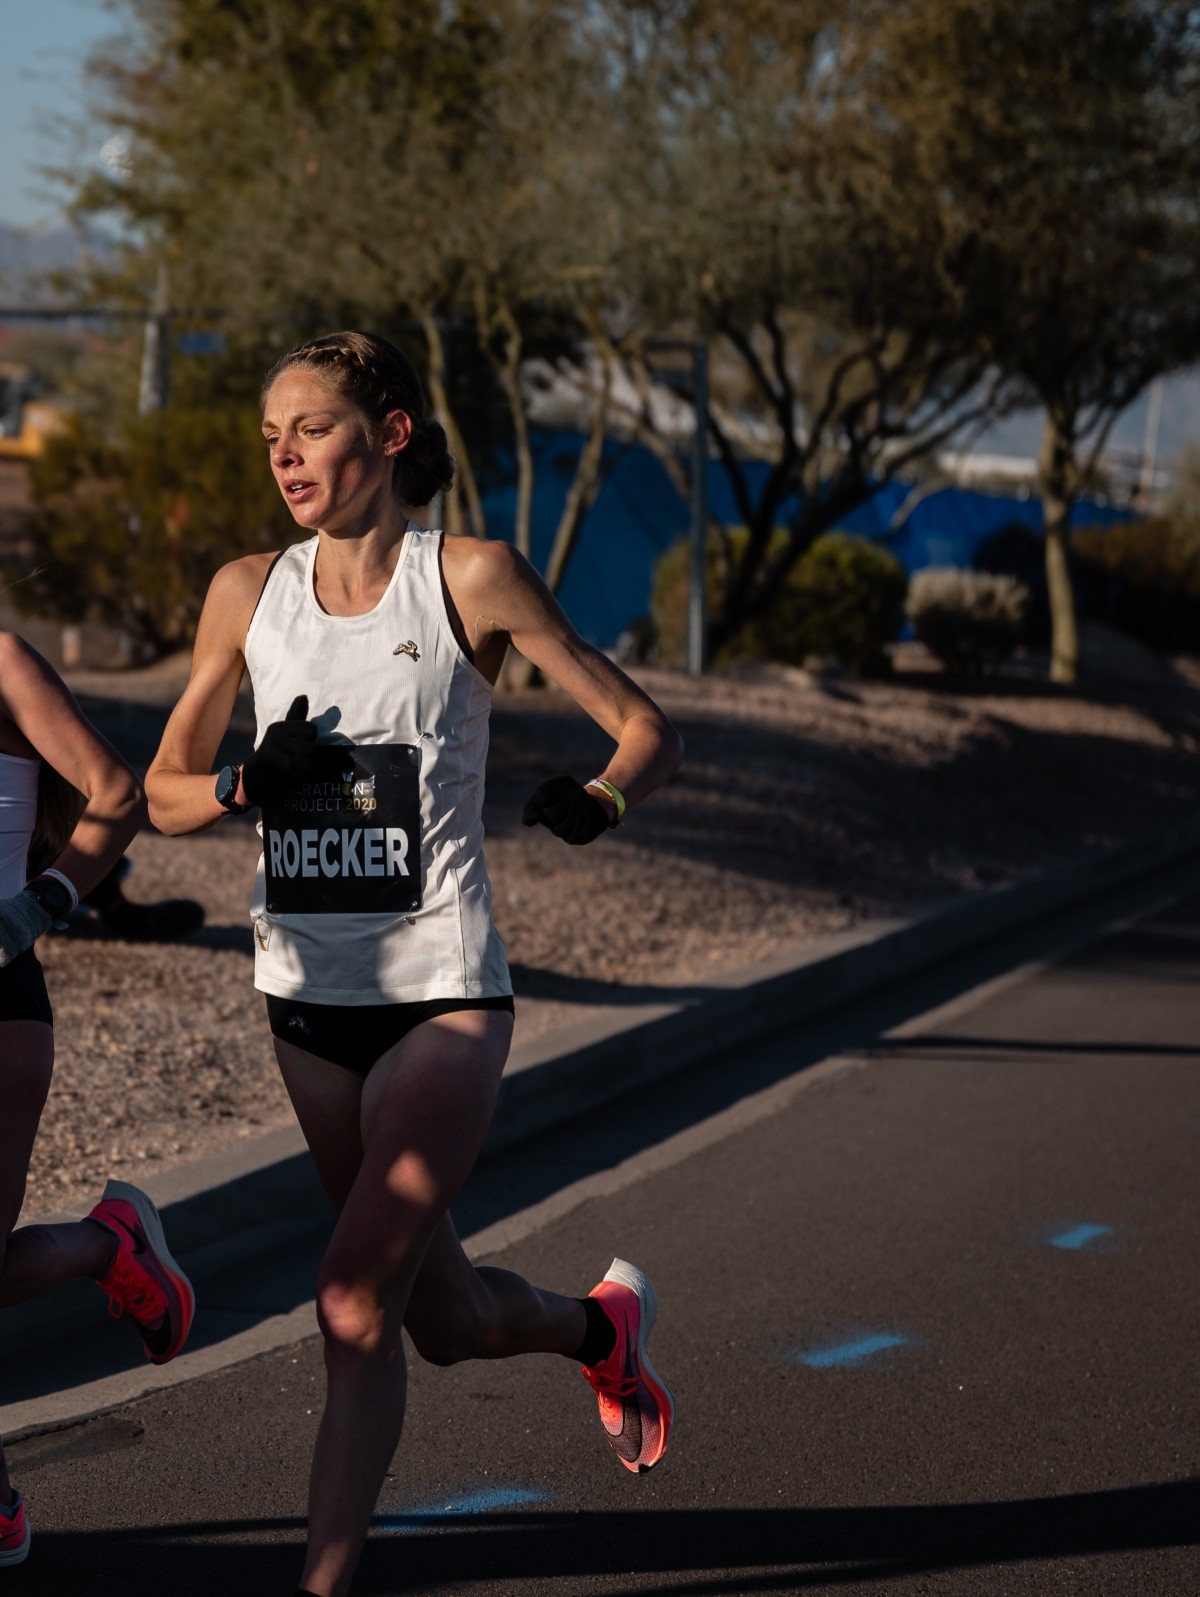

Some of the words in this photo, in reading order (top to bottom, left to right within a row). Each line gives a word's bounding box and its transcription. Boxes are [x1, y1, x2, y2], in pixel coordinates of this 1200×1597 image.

[283, 781, 364, 797] ARATHON
[283, 798, 342, 812] PROJECT
[345, 797, 377, 811] 2020
[269, 827, 410, 879] ROECKER
